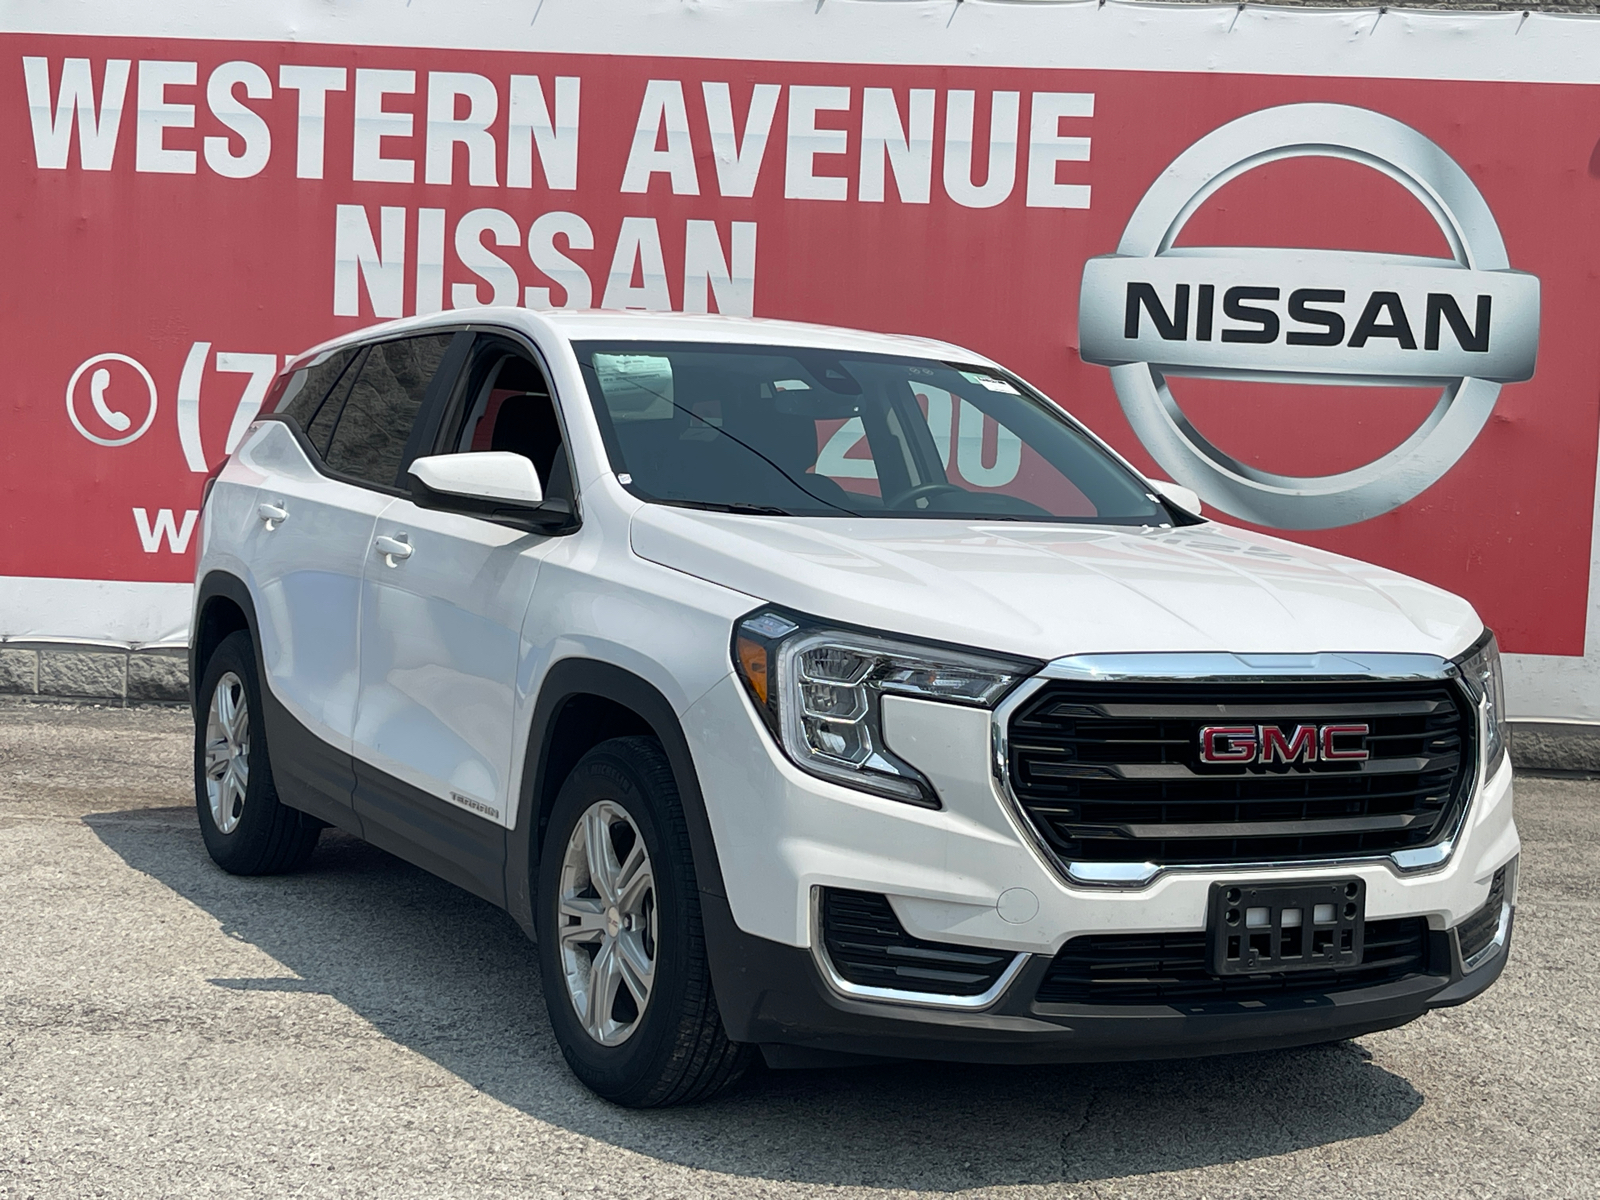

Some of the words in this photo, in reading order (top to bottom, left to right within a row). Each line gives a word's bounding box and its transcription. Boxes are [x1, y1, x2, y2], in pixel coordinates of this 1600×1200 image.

[23, 57, 580, 191] WESTERN
[620, 79, 1095, 210] AVENUE
[333, 204, 757, 318] NISSAN
[1124, 281, 1492, 353] NISSAN
[1199, 723, 1369, 764] GMC
[449, 791, 499, 819] TERRAIN
